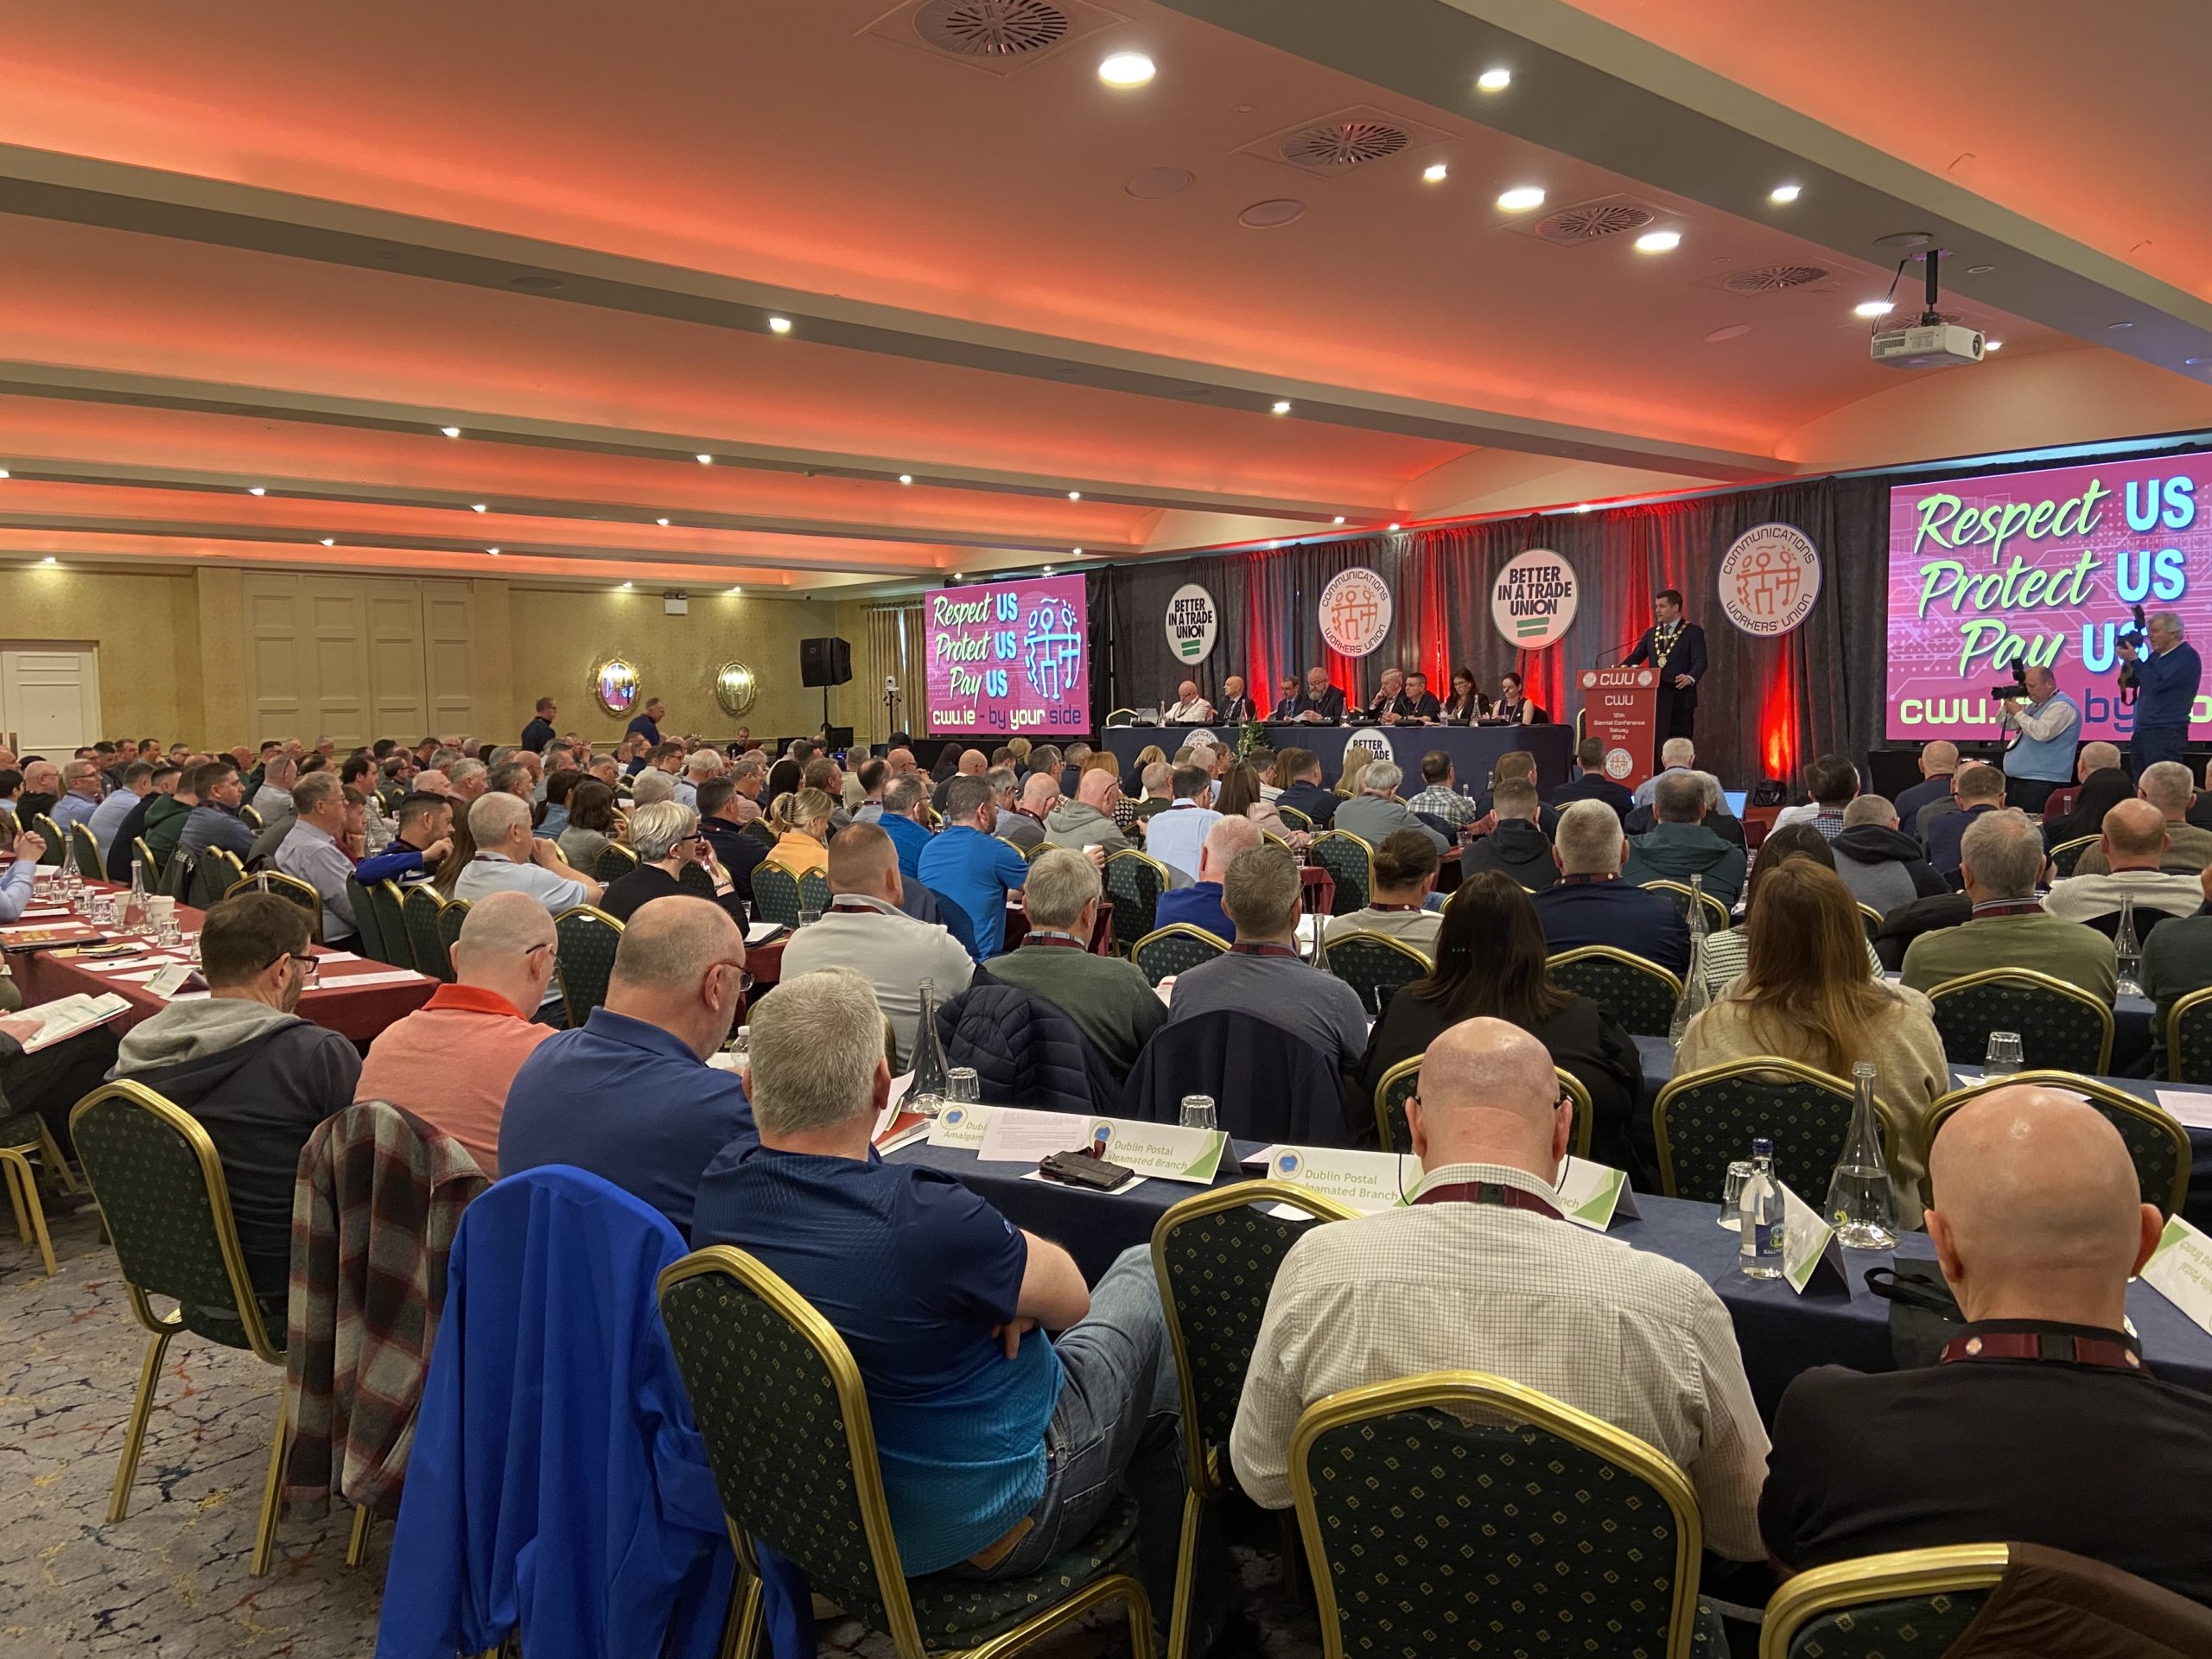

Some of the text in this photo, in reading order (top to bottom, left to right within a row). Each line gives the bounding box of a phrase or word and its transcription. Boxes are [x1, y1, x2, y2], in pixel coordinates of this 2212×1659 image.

[1914, 475, 2196, 564] Respect US
[1723, 528, 1815, 575] COMMUNICATIONS
[1510, 566, 1560, 584] BETTER
[1918, 549, 2185, 619] Protect US
[1322, 571, 1388, 607] COMMUNICATIONS
[1498, 582, 1572, 601] IN A TRADE
[933, 591, 1018, 636] Respect US
[1175, 598, 1205, 613] BETTER
[1510, 599, 1557, 616] UNION
[1726, 593, 1813, 632] WORKERS' UNION
[1168, 610, 1212, 626] IN A TRADE
[1176, 625, 1205, 639] UNION
[1364, 624, 1386, 650] UNION
[936, 631, 1016, 665] Protect US
[1959, 619, 2064, 677] Pay
[950, 666, 1007, 708] Pay US
[1600, 672, 1635, 685] CWU
[1605, 695, 1633, 706] CWU
[932, 705, 976, 725] cwu.ie
[989, 705, 1006, 729] by
[1010, 709, 1046, 730] your
[1049, 704, 1081, 725] side
[1901, 688, 2135, 733] cwu. by
[1372, 750, 1389, 760] ADE
[943, 1130, 984, 1141] Amalgam
[966, 1122, 988, 1131] Dubl
[1115, 1141, 1174, 1156] Dublin Postal
[1104, 1154, 1187, 1170] algamated Branch
[1305, 1170, 1377, 1185] Dublin Postal
[1359, 1188, 1398, 1200] Branch
